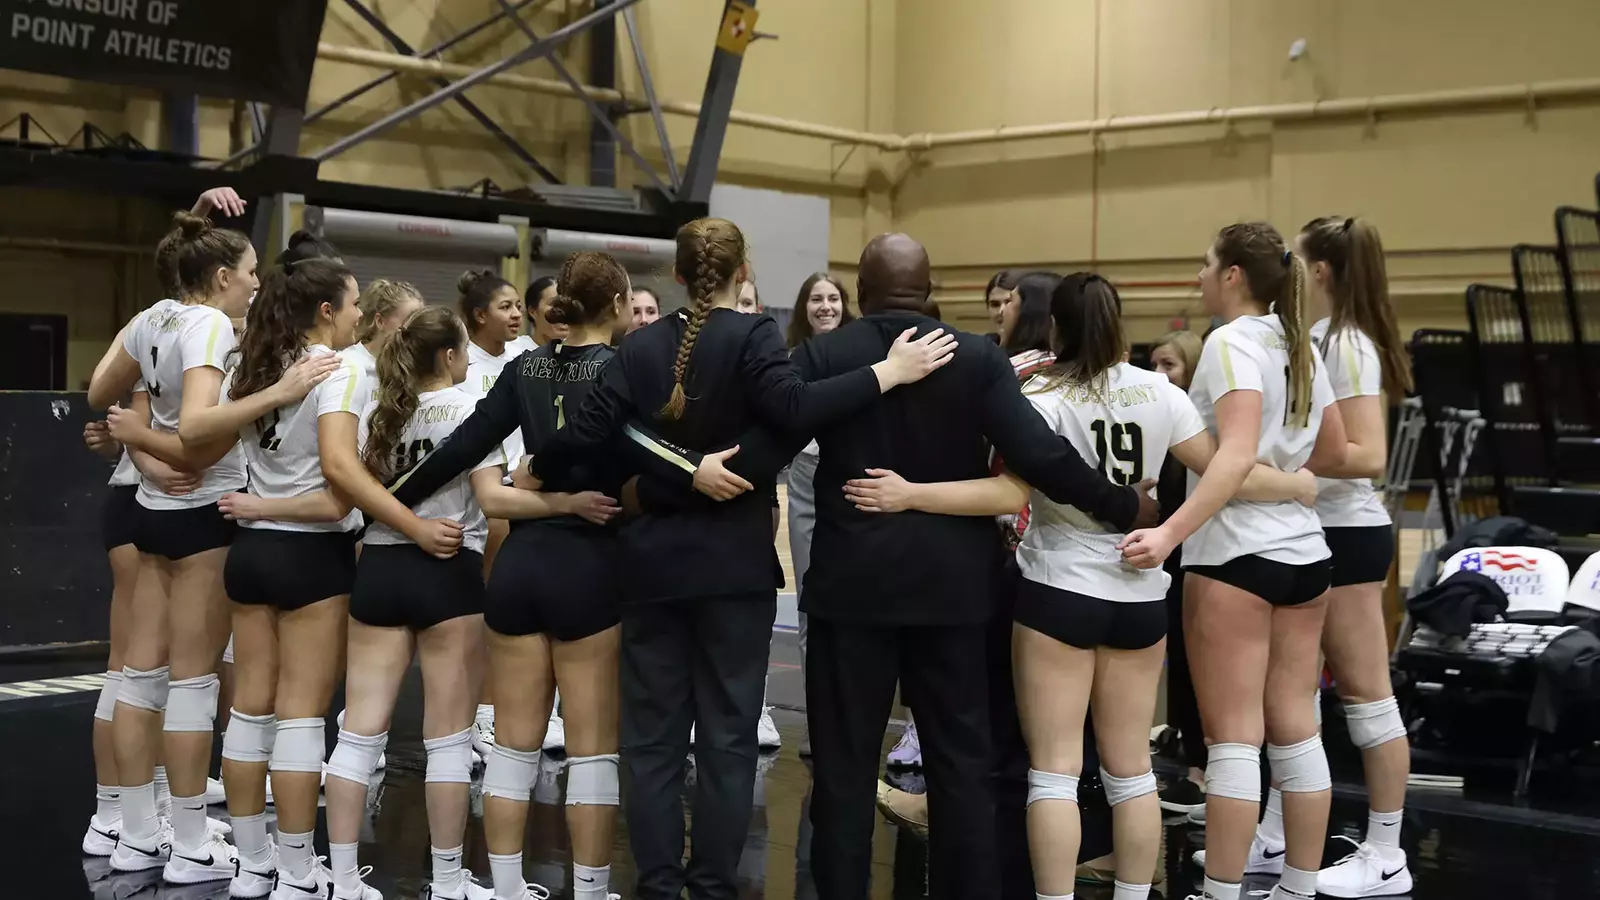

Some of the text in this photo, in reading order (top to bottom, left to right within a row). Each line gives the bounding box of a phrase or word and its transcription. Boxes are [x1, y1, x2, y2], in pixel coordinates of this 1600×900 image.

[147, 1, 178, 26] OF
[11, 13, 232, 70] POINT ATHLETICS
[1108, 384, 1156, 409] POINT
[1090, 418, 1143, 487] 19
